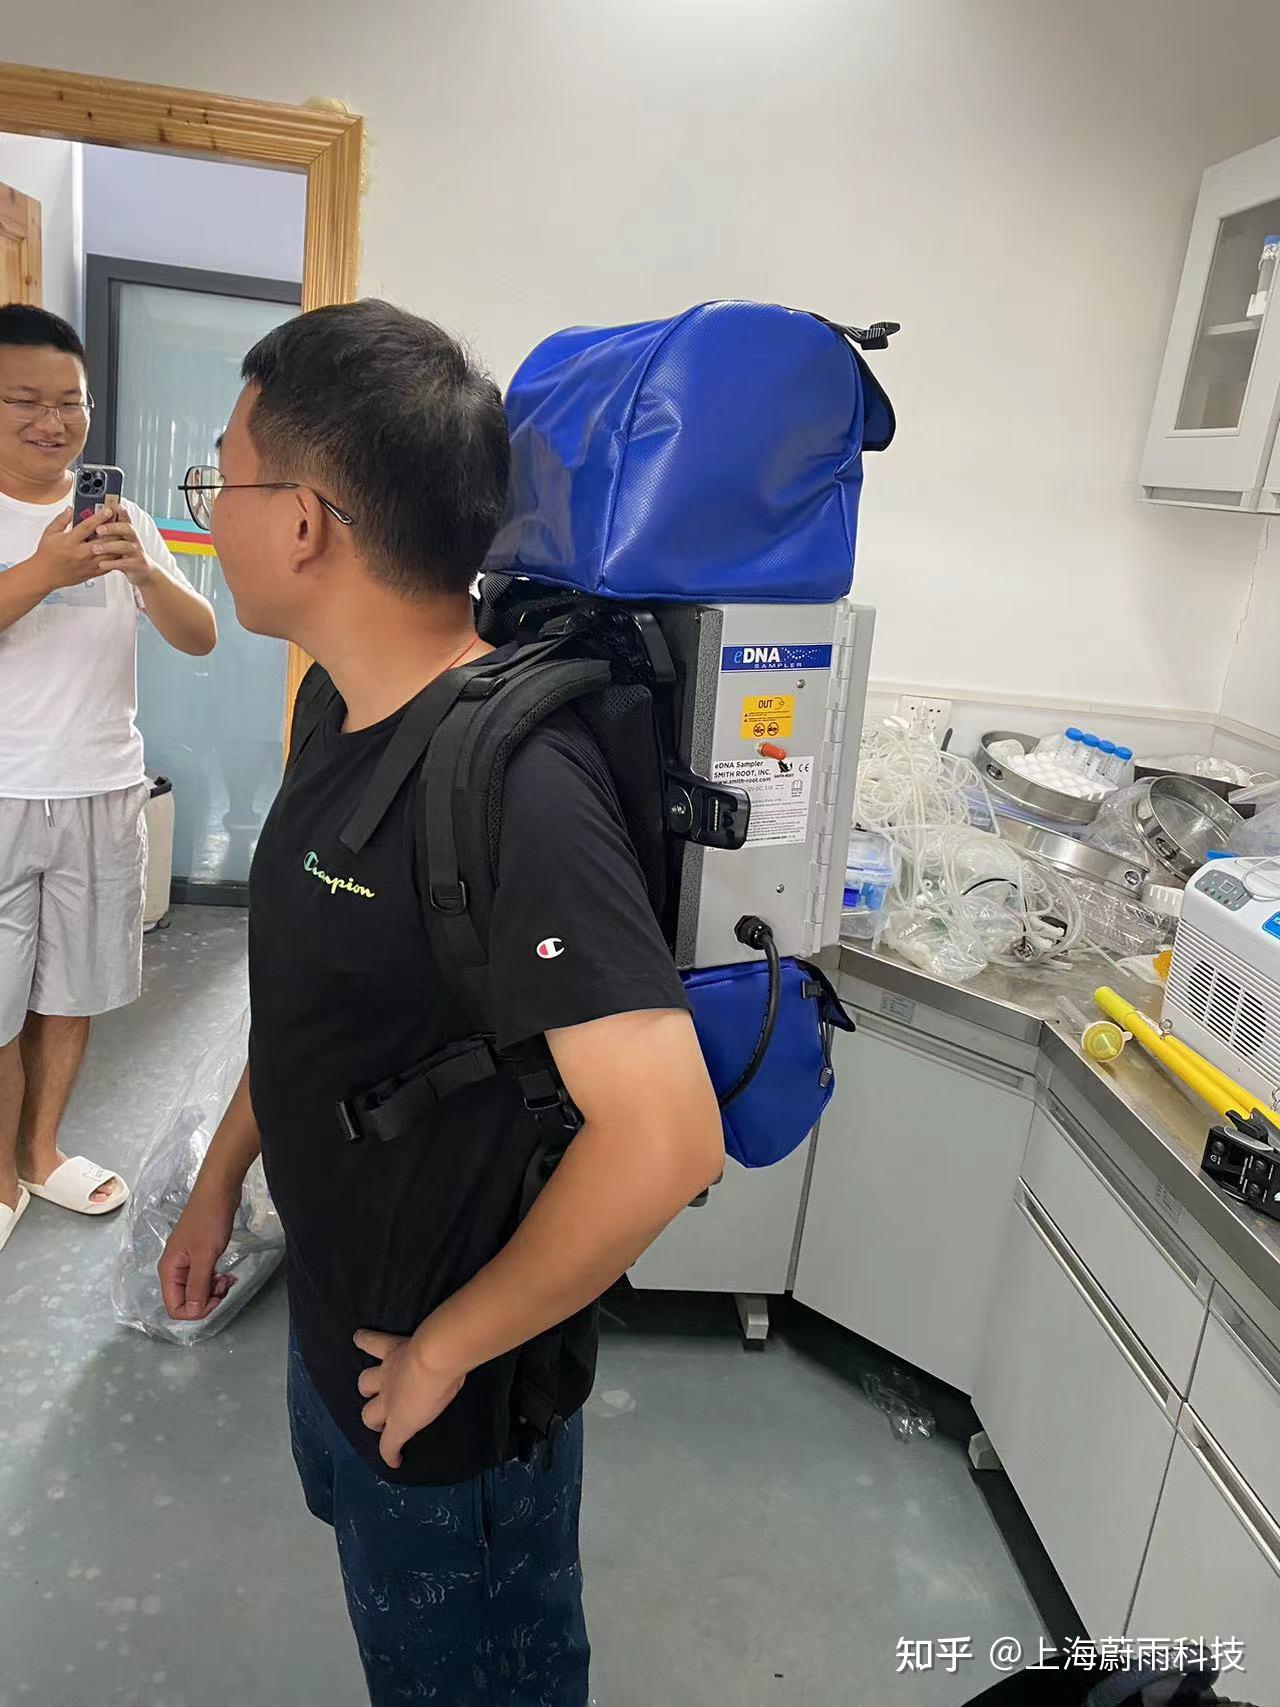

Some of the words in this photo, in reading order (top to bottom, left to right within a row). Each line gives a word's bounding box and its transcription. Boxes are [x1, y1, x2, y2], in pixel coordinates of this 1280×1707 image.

[734, 648, 780, 663] eDNA
[758, 700, 773, 708] OUT
[714, 761, 735, 769] eDNA
[736, 760, 764, 768] Sampler
